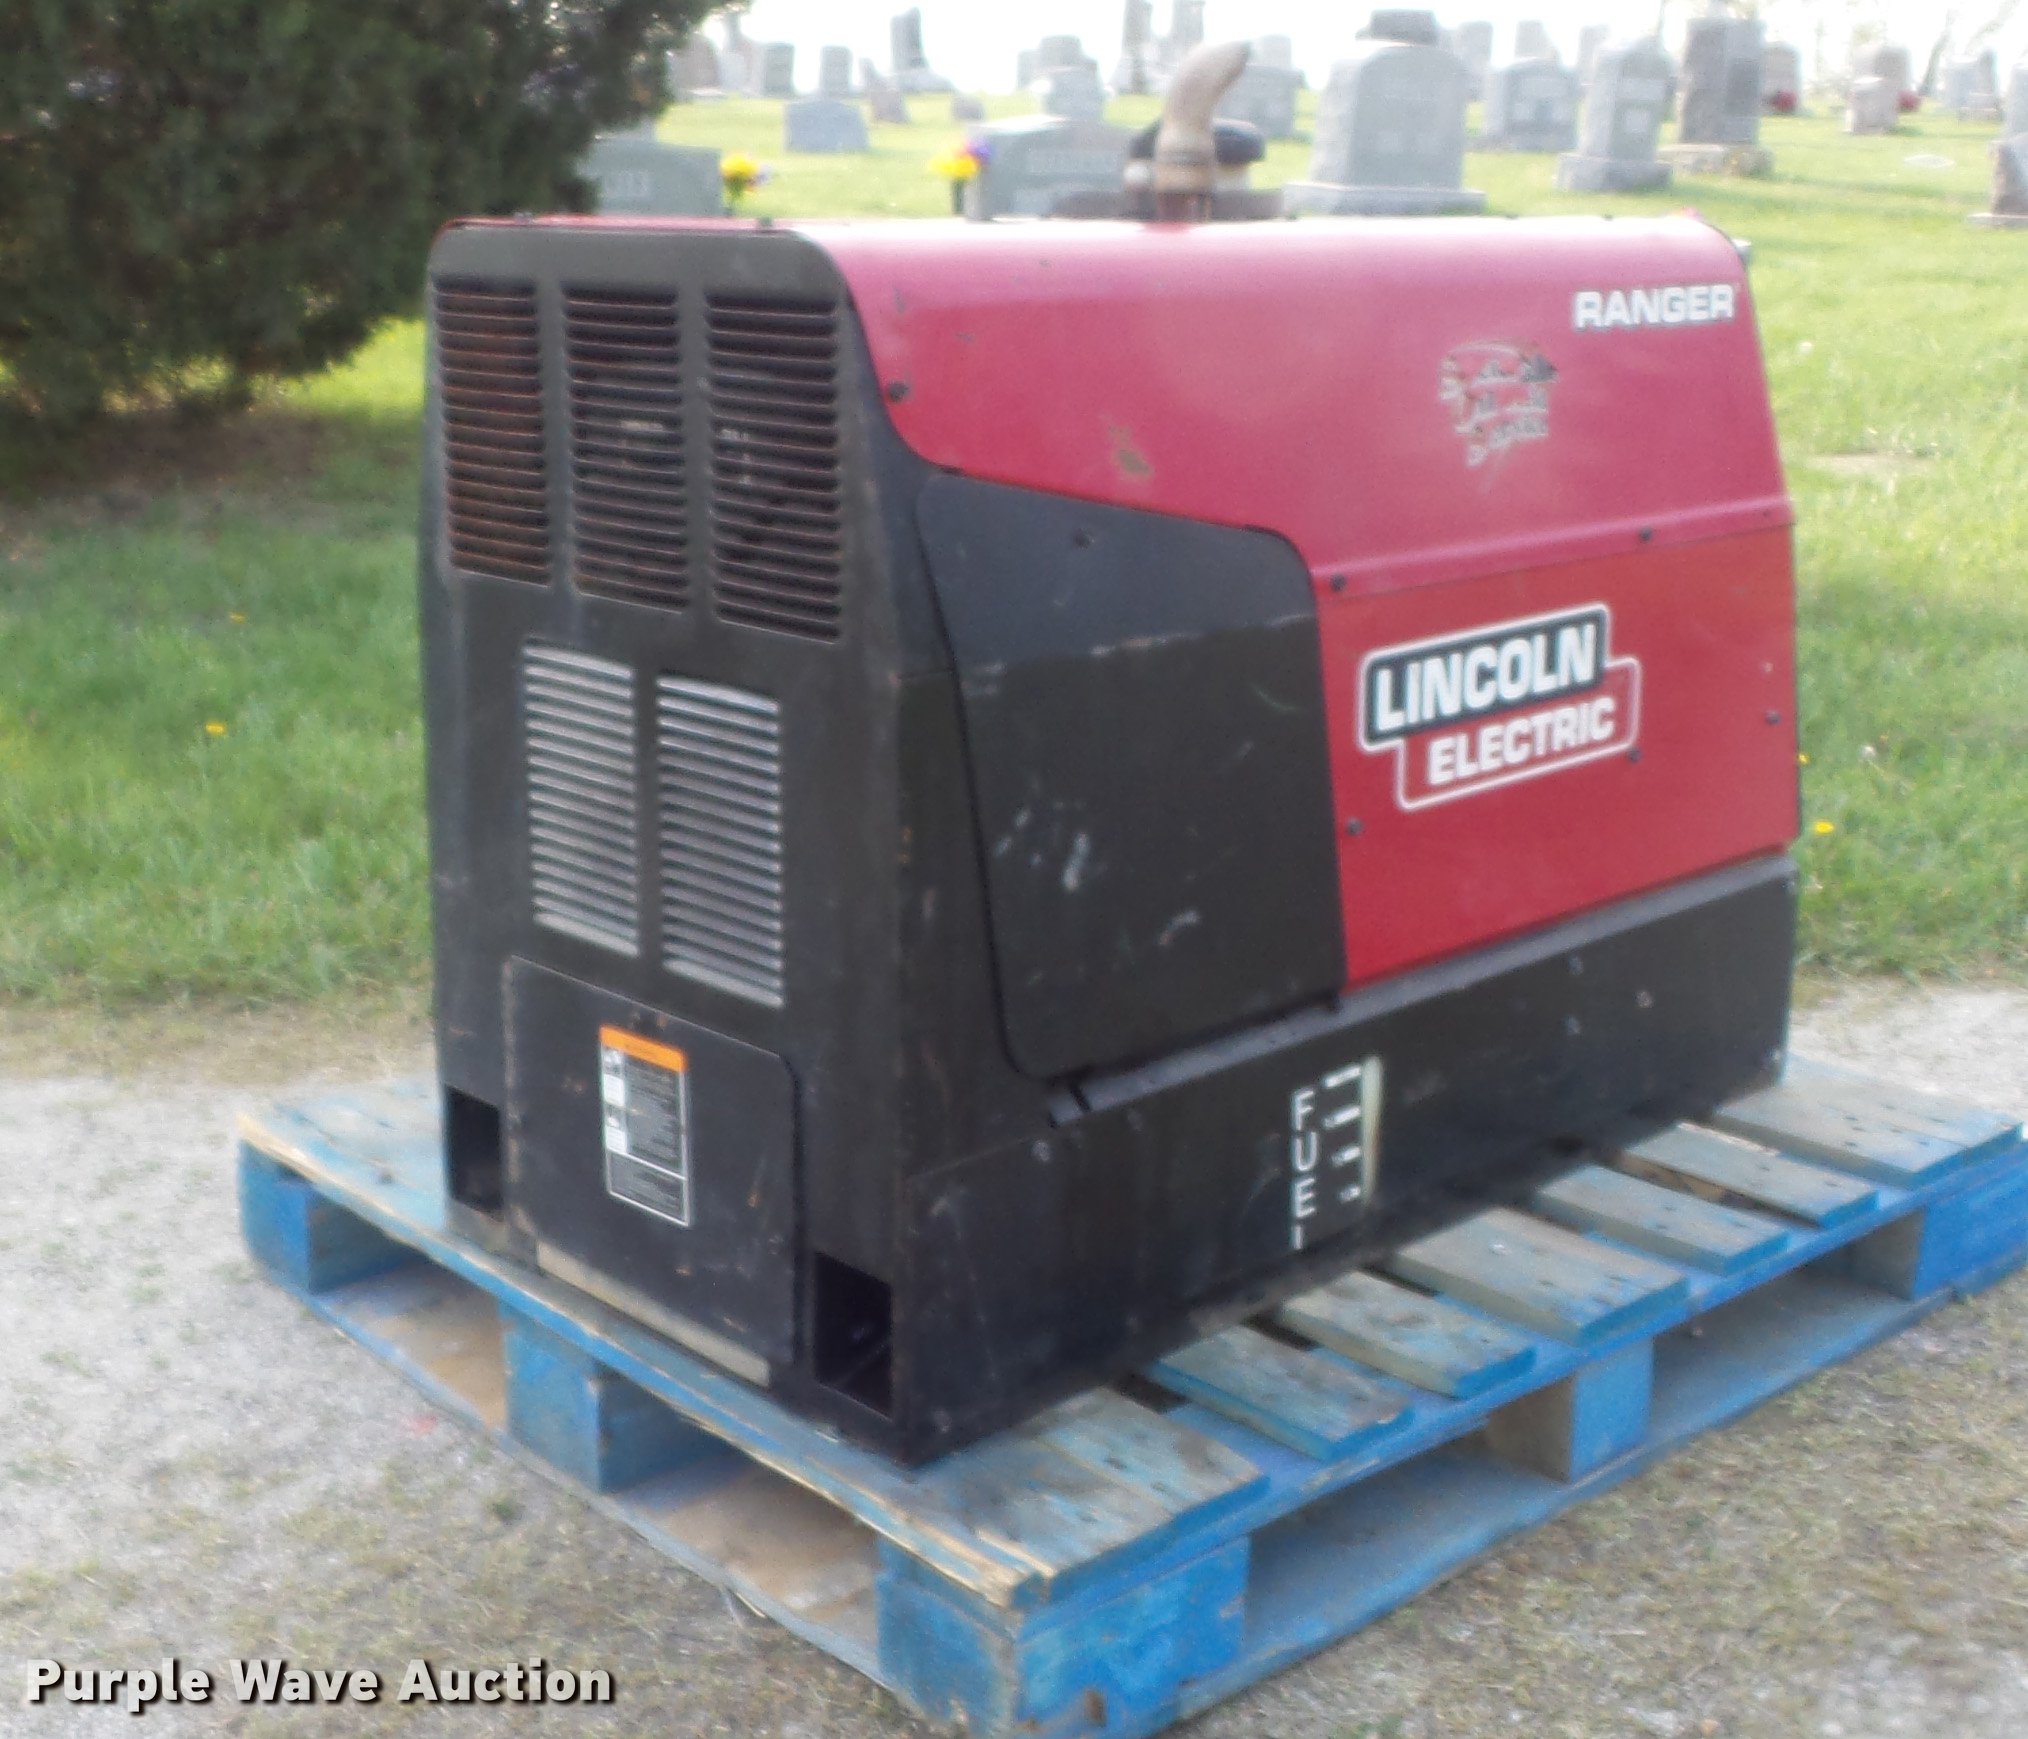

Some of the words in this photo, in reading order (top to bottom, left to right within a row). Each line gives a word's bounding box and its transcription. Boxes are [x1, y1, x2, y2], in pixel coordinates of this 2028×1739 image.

[1572, 283, 1735, 330] RANGER
[1375, 623, 1597, 732] LINCOLN
[1428, 696, 1616, 786] ELECTRIC
